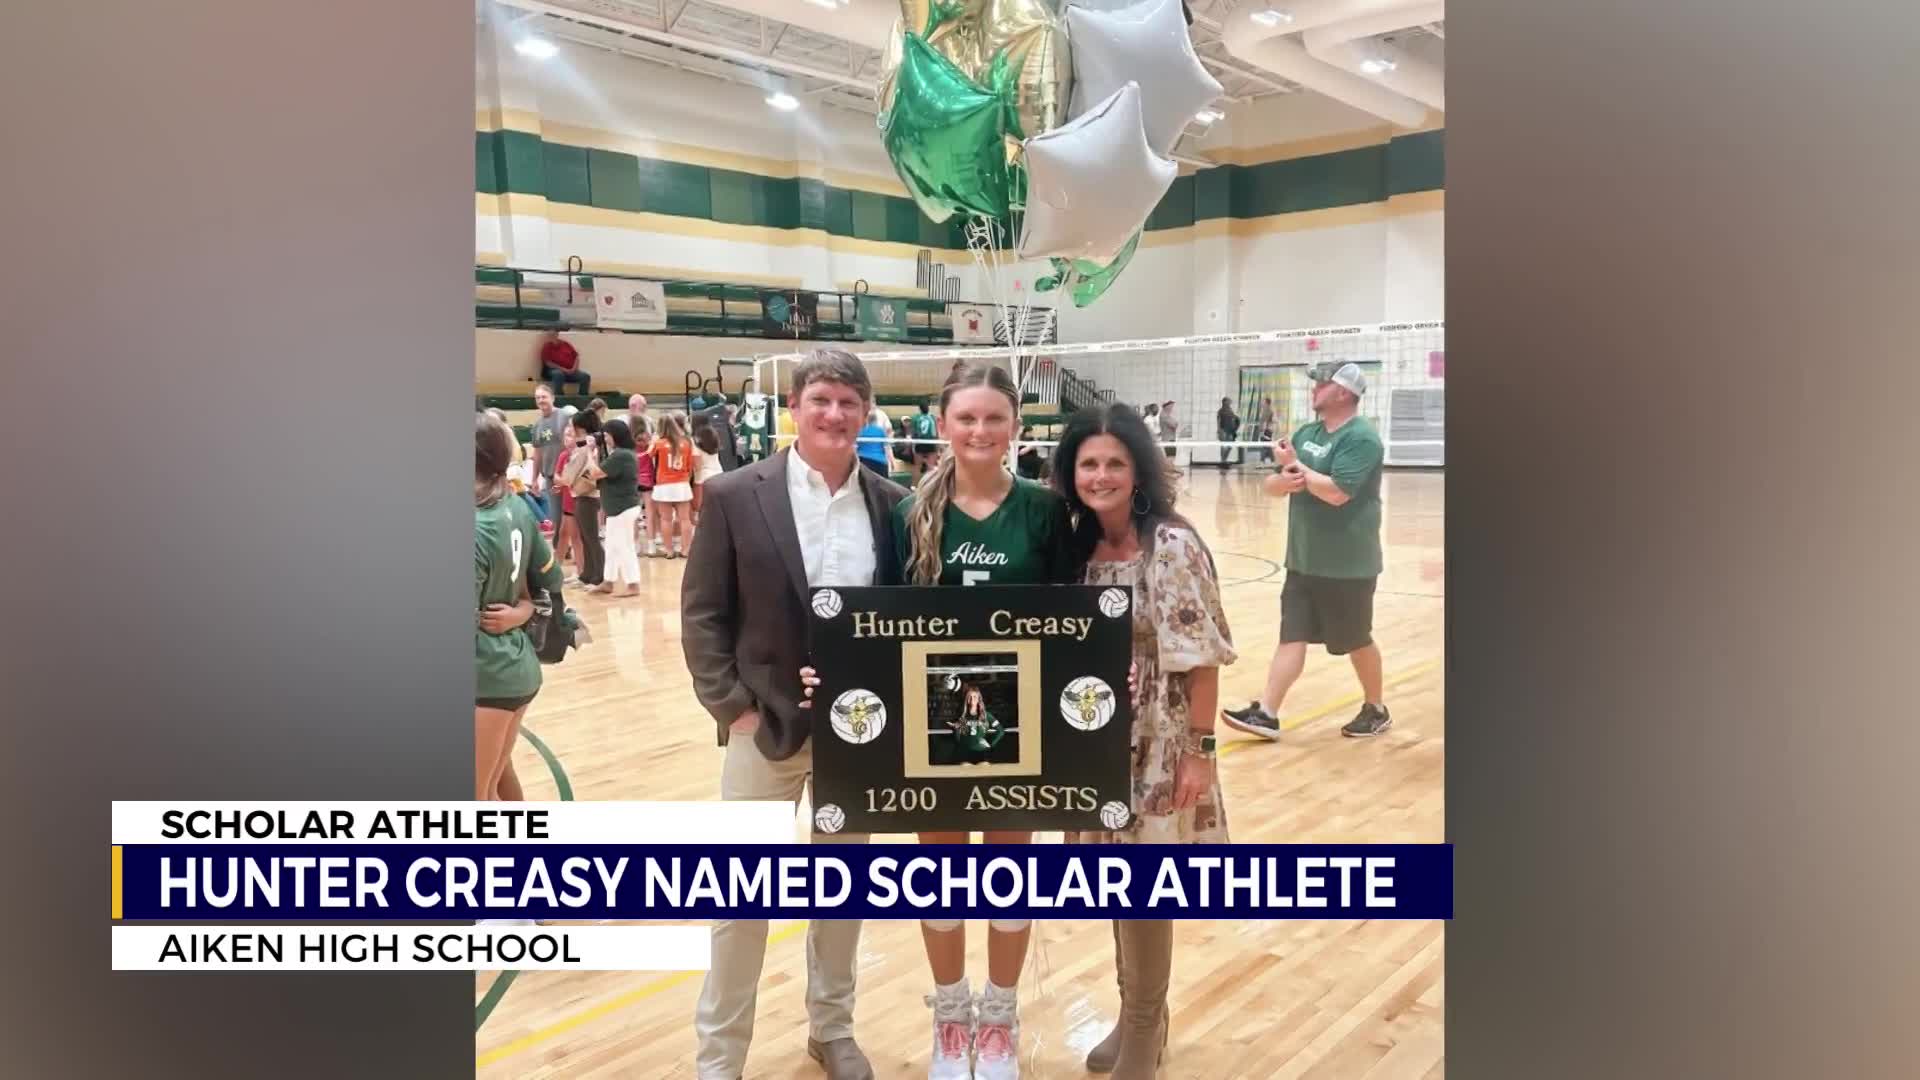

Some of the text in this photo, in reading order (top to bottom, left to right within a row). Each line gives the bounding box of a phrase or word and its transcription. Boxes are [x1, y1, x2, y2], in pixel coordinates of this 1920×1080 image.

[510, 528, 522, 583] 9
[946, 541, 1009, 565] Aiken
[851, 609, 1094, 641] Hunter Creasy
[865, 784, 1098, 813] 1200 ASSISTS
